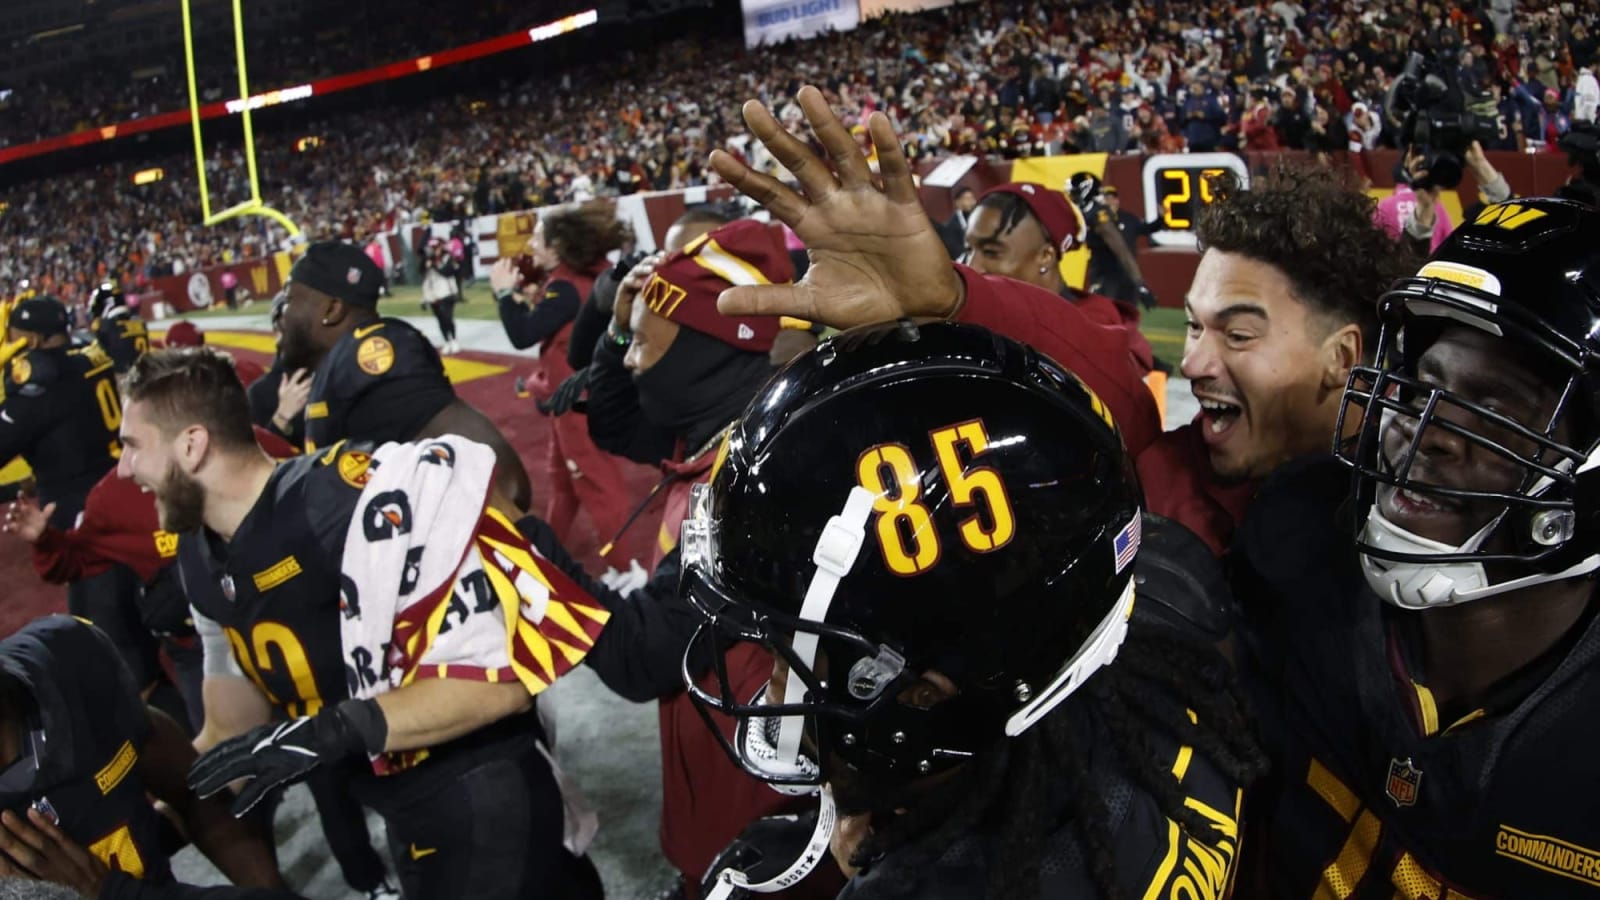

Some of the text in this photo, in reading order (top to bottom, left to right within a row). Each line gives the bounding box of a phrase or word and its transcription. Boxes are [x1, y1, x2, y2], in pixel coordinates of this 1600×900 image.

[758, 0, 841, 27] BUD LIGHT
[855, 417, 1017, 577] 85
[1390, 777, 1414, 802] NFL
[1496, 830, 1600, 881] COMMANDERS
